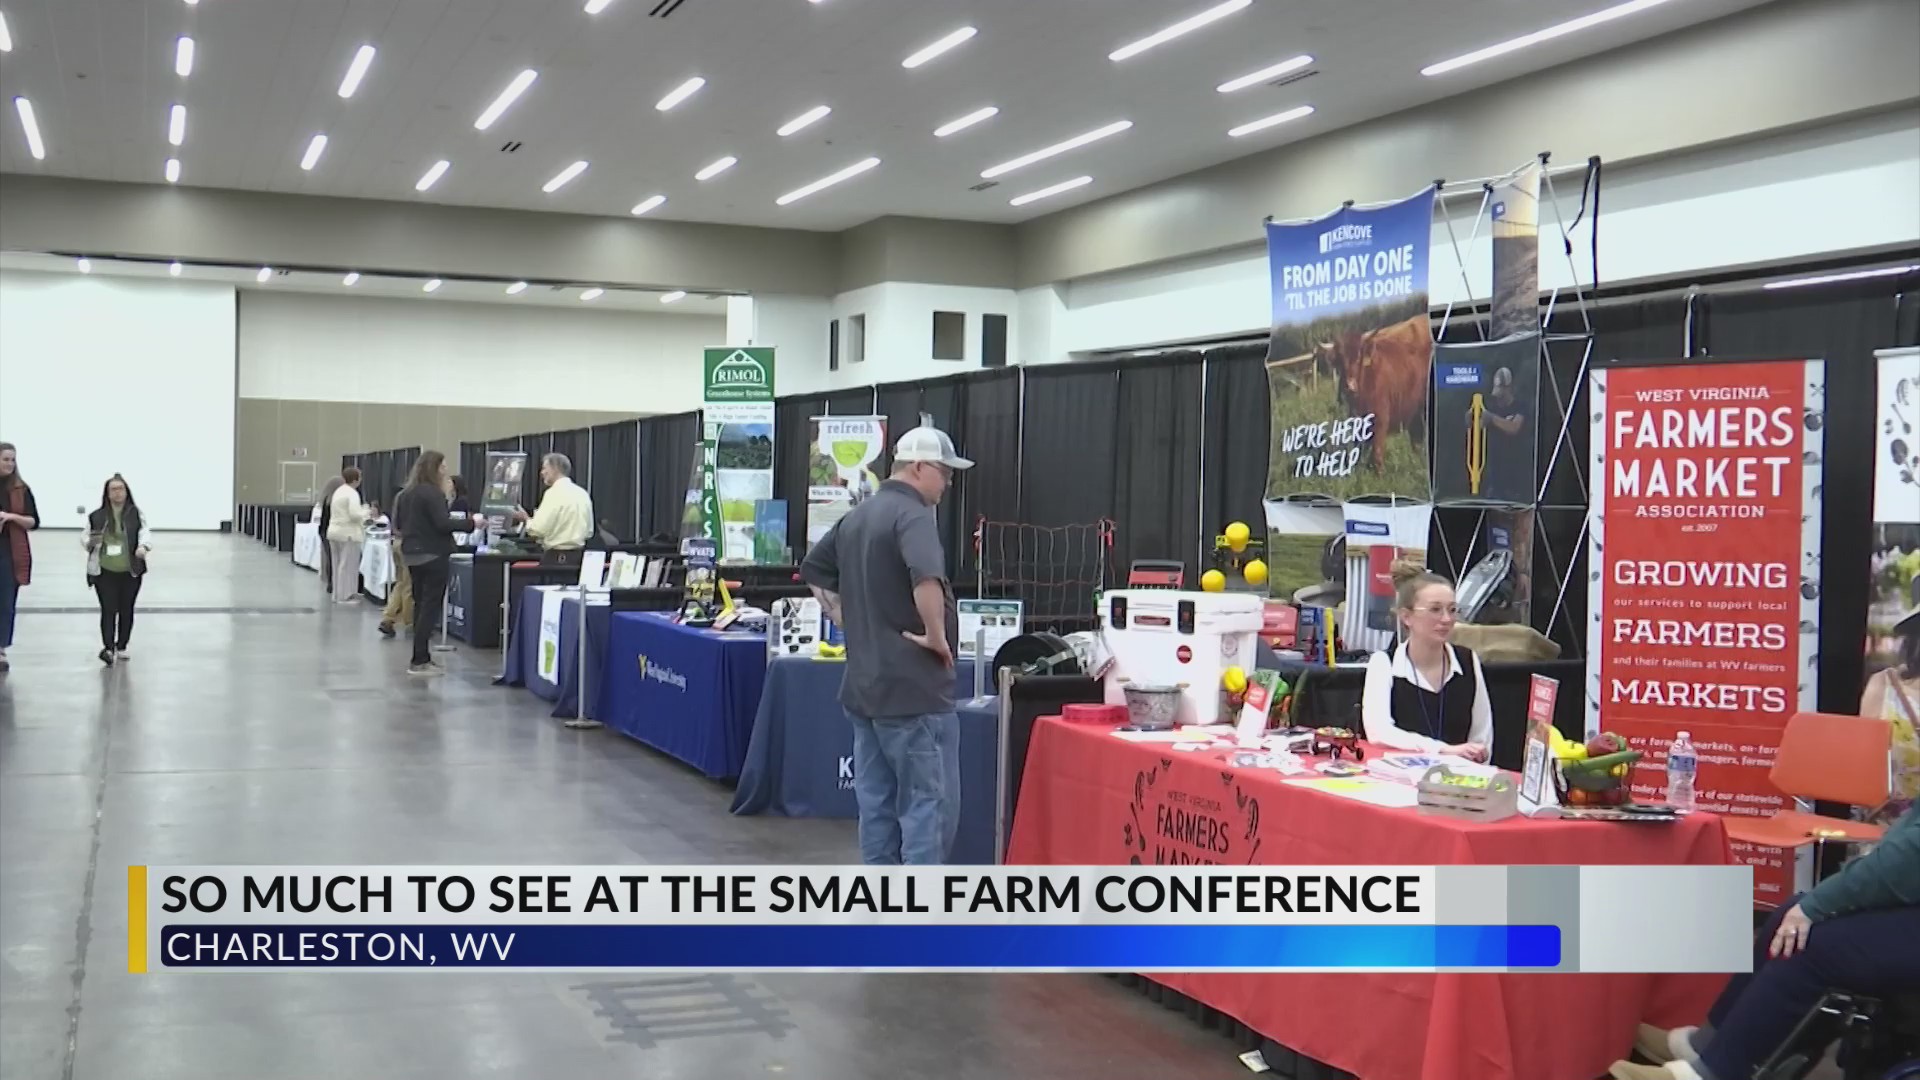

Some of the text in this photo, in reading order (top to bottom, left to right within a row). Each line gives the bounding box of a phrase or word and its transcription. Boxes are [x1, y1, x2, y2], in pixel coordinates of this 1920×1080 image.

[1332, 224, 1373, 242] KENCOVE
[1283, 243, 1414, 290] FROM DAY ONE
[1306, 287, 1331, 308] THE
[1332, 283, 1357, 304] JOB
[1359, 281, 1372, 300] IS
[1373, 275, 1413, 298] DONE
[717, 369, 761, 382] RIMOL
[1635, 386, 1770, 402] WEST VIRGINIA
[827, 421, 874, 434] refresh
[1282, 413, 1375, 452] WE'RE HERE
[1614, 406, 1795, 449] FARMERS
[1295, 447, 1360, 478] TO HELP
[1613, 456, 1791, 498] MARKET
[1635, 505, 1765, 518] ASSOCIATION
[1614, 559, 1788, 589] GROWING
[1613, 597, 1788, 611] our services to support local
[1612, 618, 1786, 650] FARMERS
[1612, 655, 1786, 673] and their families at WV farmers
[1610, 678, 1787, 713] MARKETS
[1629, 737, 1647, 746] are
[1168, 791, 1222, 812] WEST VIRGINIA
[1631, 785, 1657, 796] today
[1156, 803, 1230, 854] FARMERS
